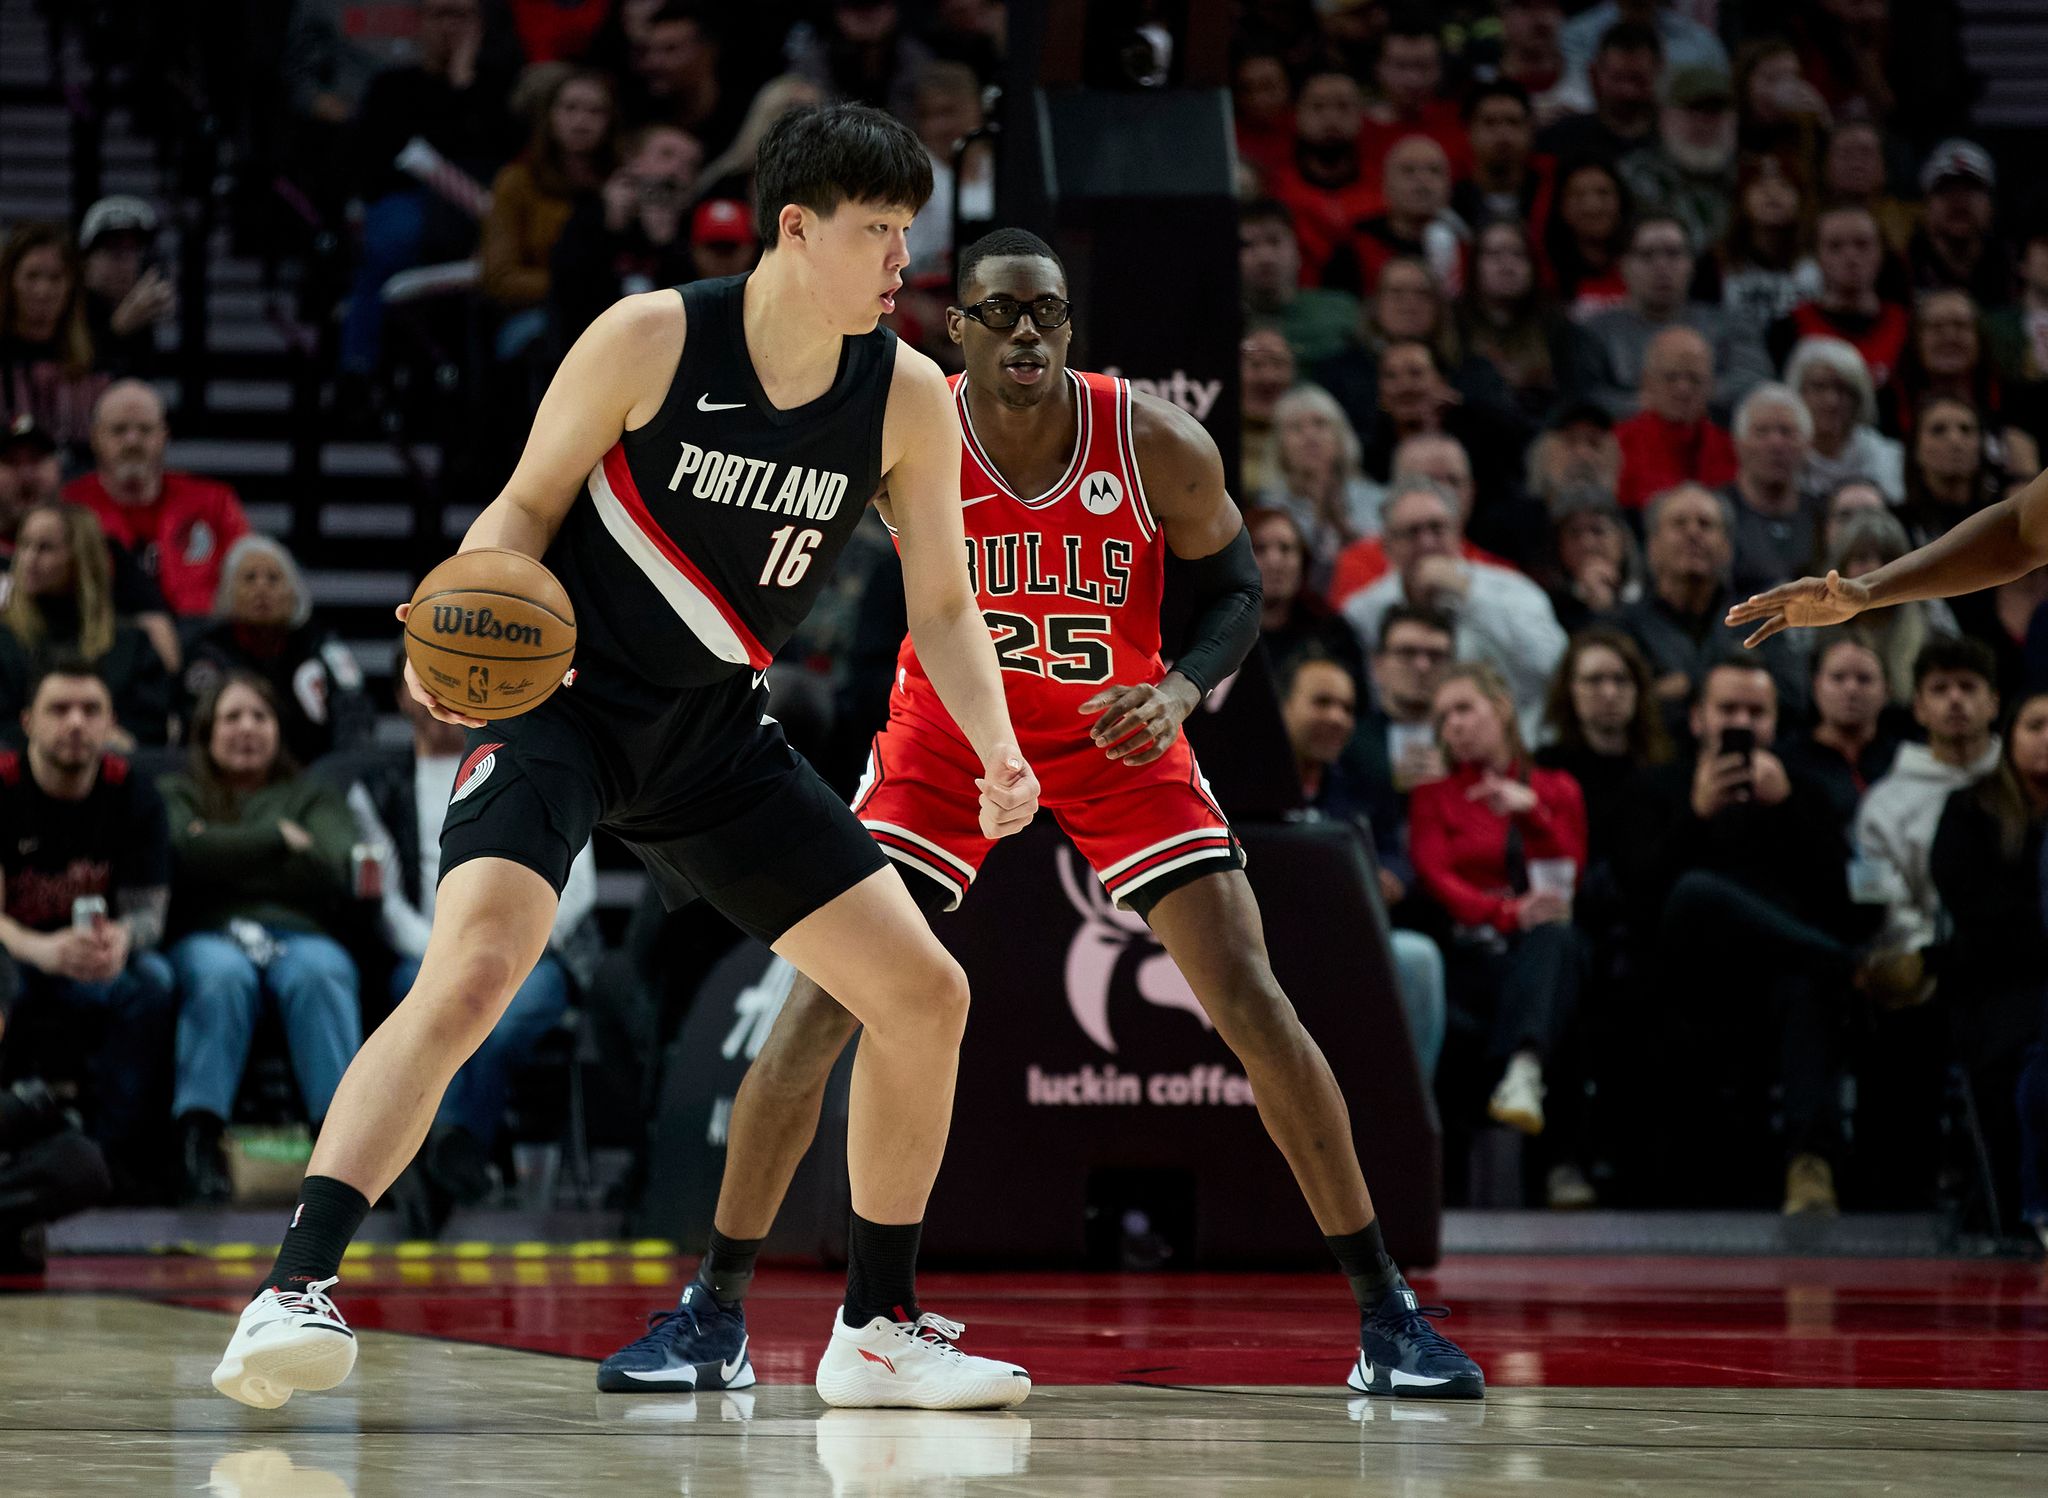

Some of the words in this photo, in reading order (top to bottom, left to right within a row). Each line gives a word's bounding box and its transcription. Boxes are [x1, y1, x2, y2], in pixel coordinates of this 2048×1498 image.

[668, 441, 849, 522] PORTLAND
[757, 525, 823, 588] 16
[432, 604, 542, 647] Wilson
[982, 608, 1114, 685] 25
[1026, 1062, 1142, 1106] luckin
